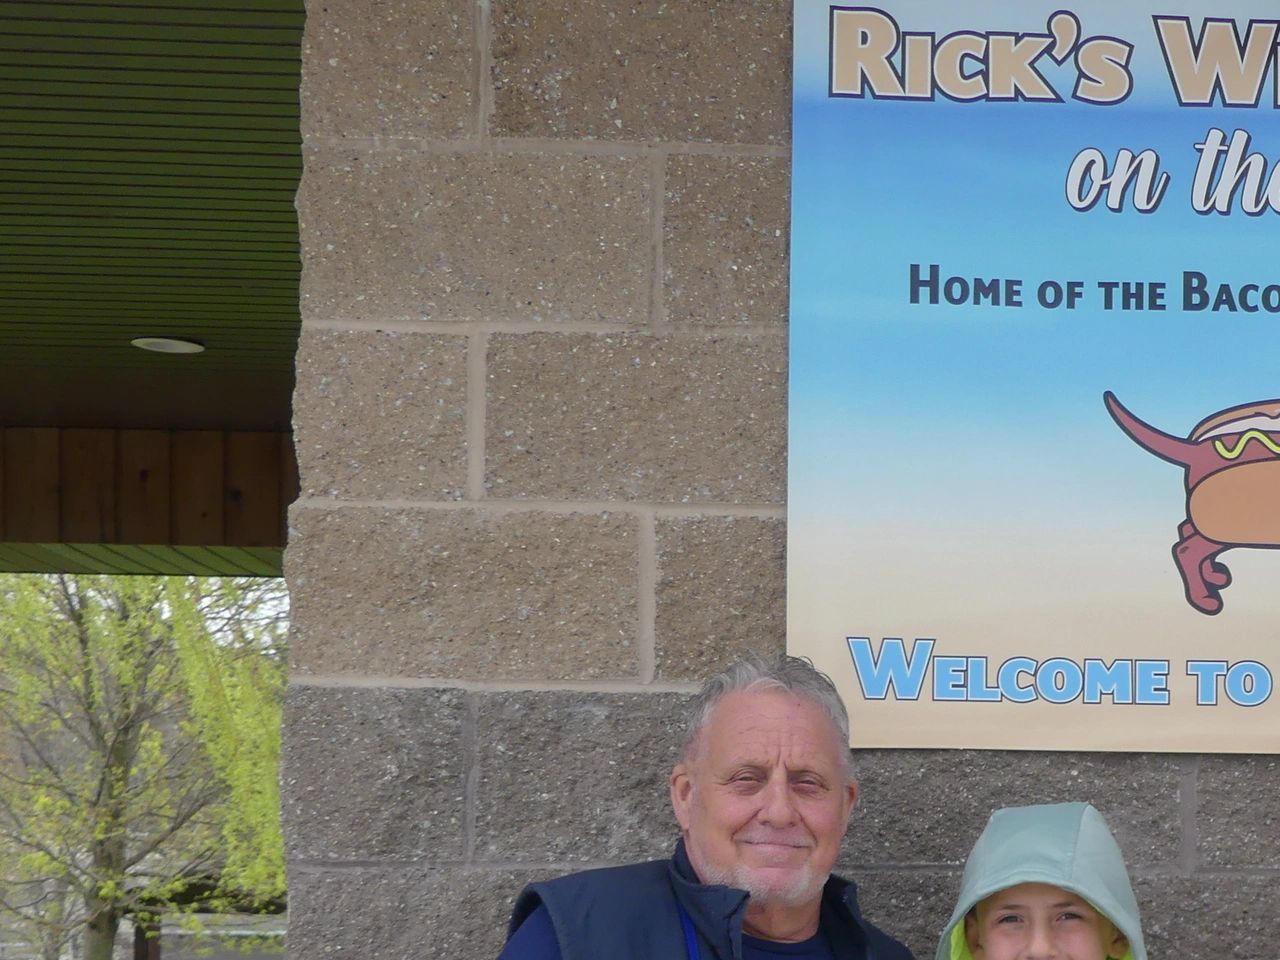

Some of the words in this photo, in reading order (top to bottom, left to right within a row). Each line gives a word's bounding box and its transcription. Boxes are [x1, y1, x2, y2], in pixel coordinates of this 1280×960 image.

[829, 5, 1134, 105] RICK'S
[1066, 149, 1168, 212] on
[909, 263, 1023, 308] HOME
[1037, 280, 1085, 310] OF
[1097, 281, 1167, 311] THE
[846, 636, 1171, 706] WELCOME
[1185, 659, 1274, 708] TO
